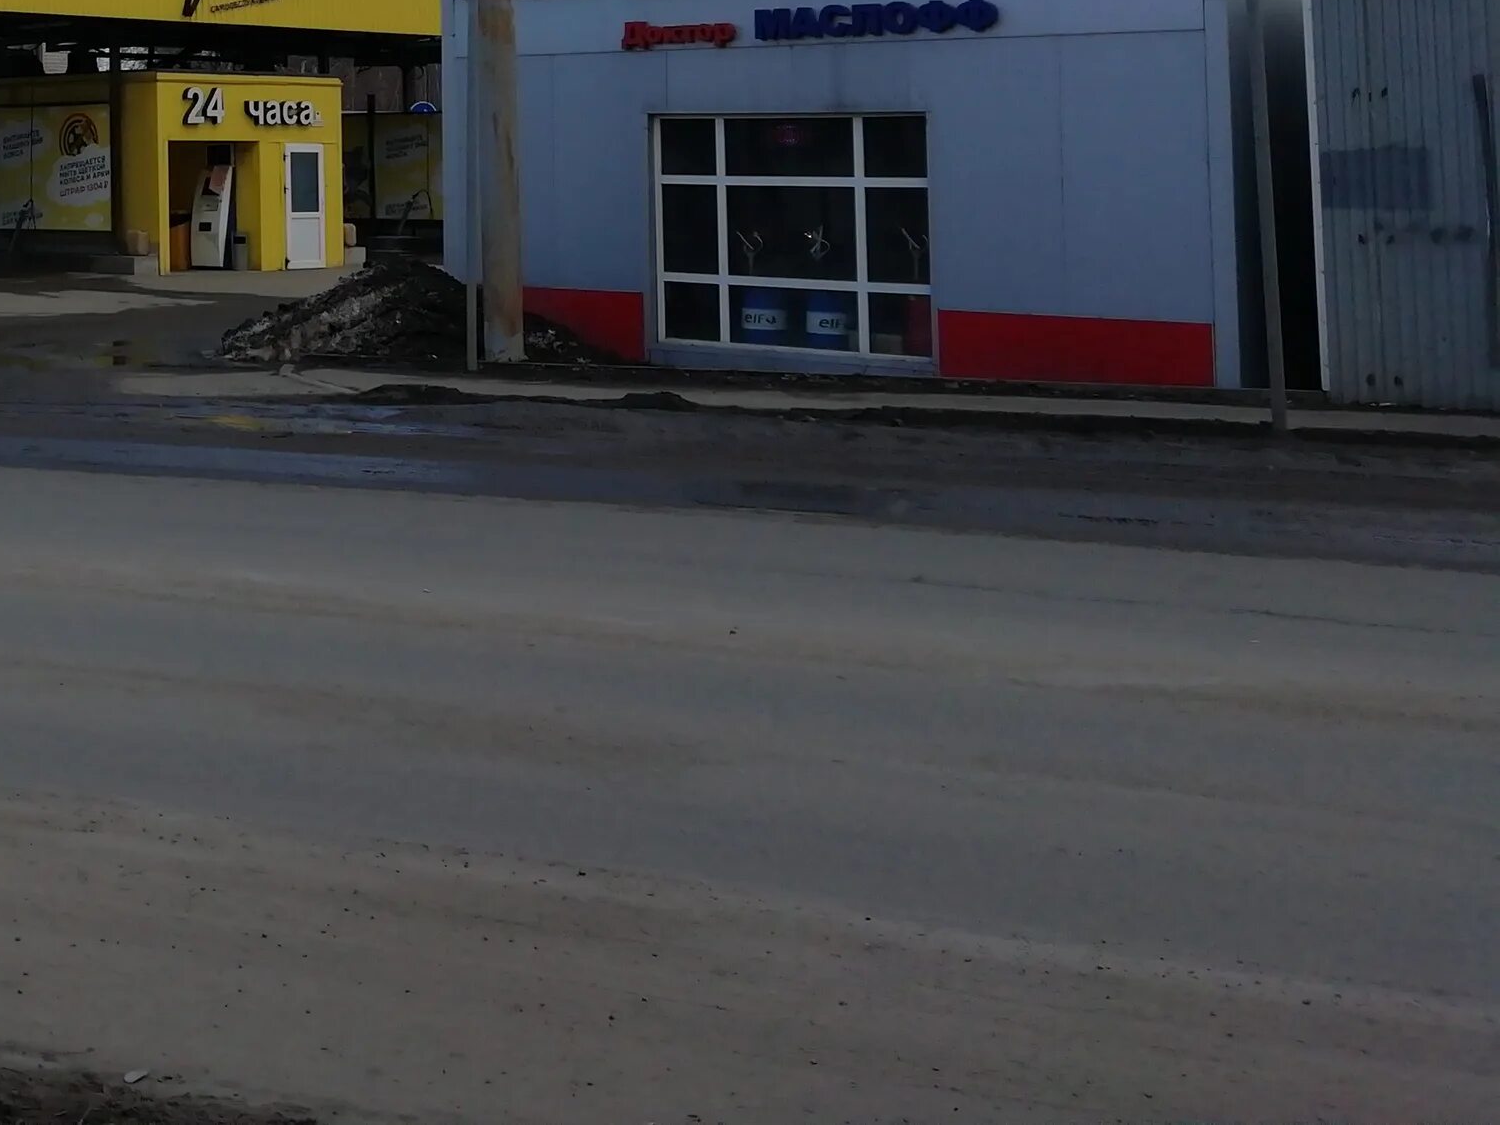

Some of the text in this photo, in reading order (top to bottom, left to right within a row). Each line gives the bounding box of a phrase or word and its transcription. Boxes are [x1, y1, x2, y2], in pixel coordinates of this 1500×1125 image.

[622, 0, 999, 50] Доктор МАСЛОФФ
[182, 86, 314, 127] 24 часа
